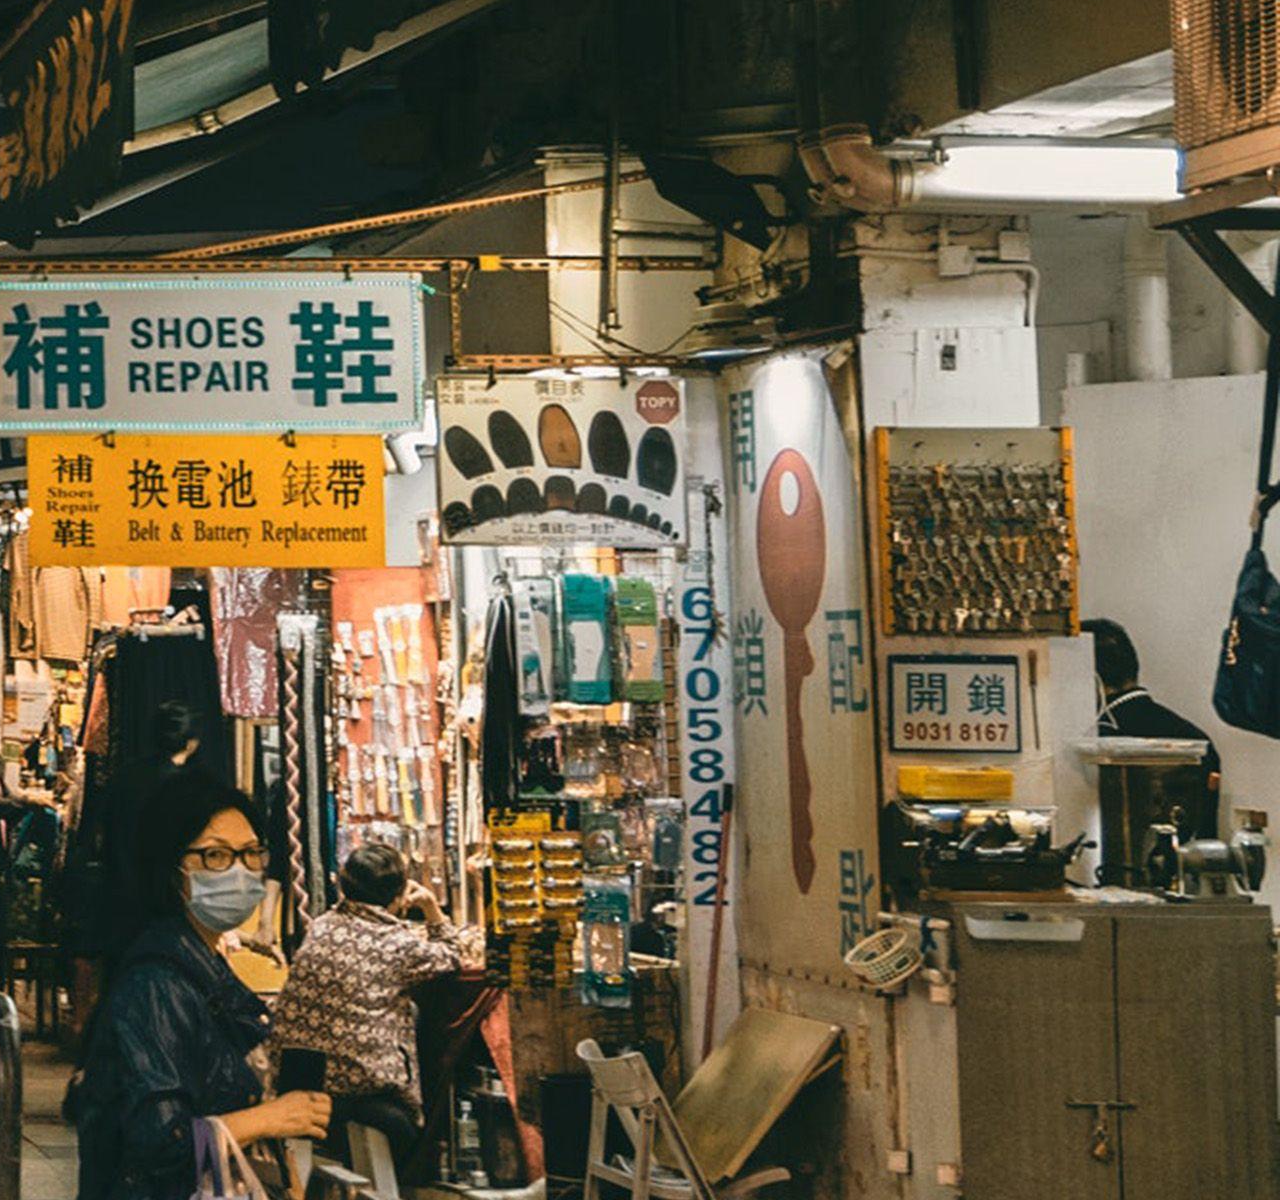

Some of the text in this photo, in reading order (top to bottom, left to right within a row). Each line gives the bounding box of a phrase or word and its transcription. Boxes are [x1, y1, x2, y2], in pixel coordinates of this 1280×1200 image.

[130, 317, 265, 350] SHOES
[2, 301, 110, 410] 補
[289, 301, 399, 408] 鞋
[128, 361, 270, 393] REPAIR
[639, 397, 677, 409] TOPY
[52, 454, 94, 484] 補
[47, 487, 95, 499] Shoes
[46, 501, 101, 517] Repair
[52, 519, 96, 549] 鞋
[127, 519, 368, 549] Belt & Battery Replacement
[905, 670, 1008, 715] 開鎖
[903, 722, 1009, 742] 9031 8167
